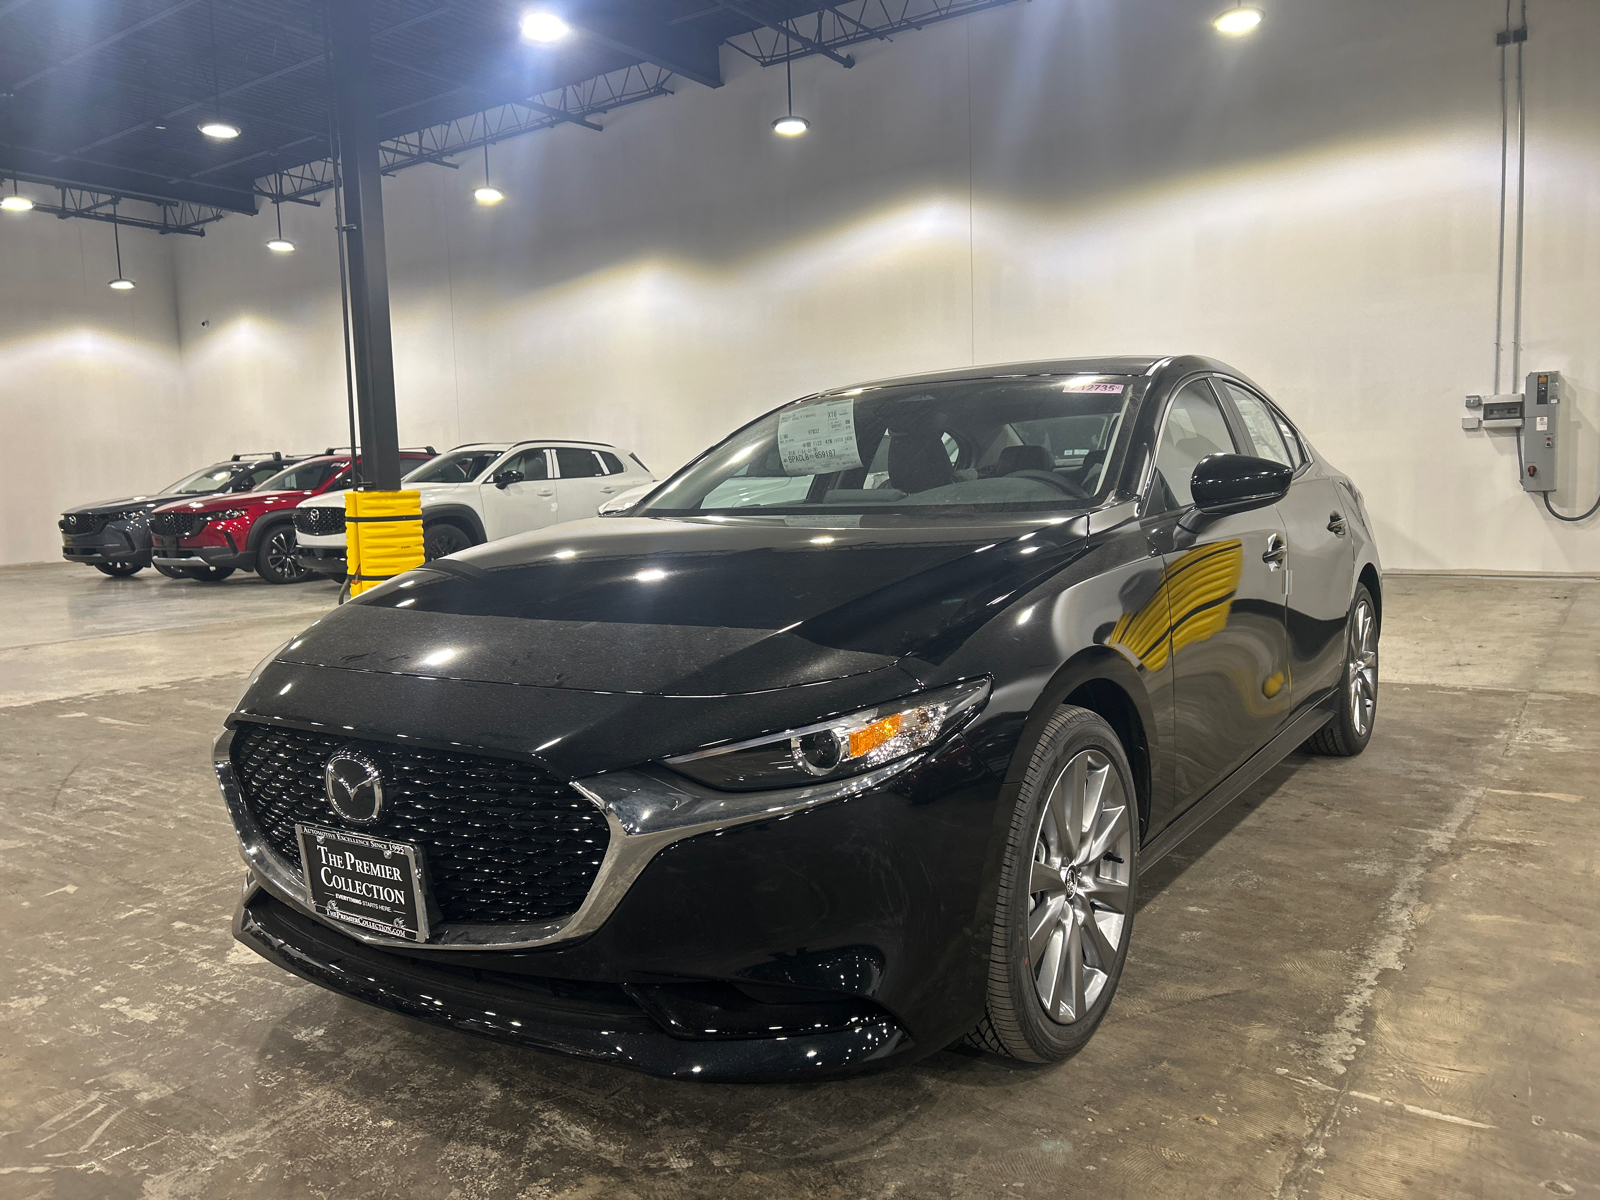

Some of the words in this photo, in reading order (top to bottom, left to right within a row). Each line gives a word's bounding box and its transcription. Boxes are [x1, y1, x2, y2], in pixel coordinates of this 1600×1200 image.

[303, 827, 336, 840] AUTOMOTIVE
[336, 832, 369, 846] EXCELLENCE
[370, 840, 388, 850] SINCE
[316, 844, 345, 869] THE
[344, 851, 403, 882] PREMIER
[320, 866, 405, 905] COLLECTION
[335, 893, 362, 906] EVERYTHING
[362, 900, 379, 910] STARTS
